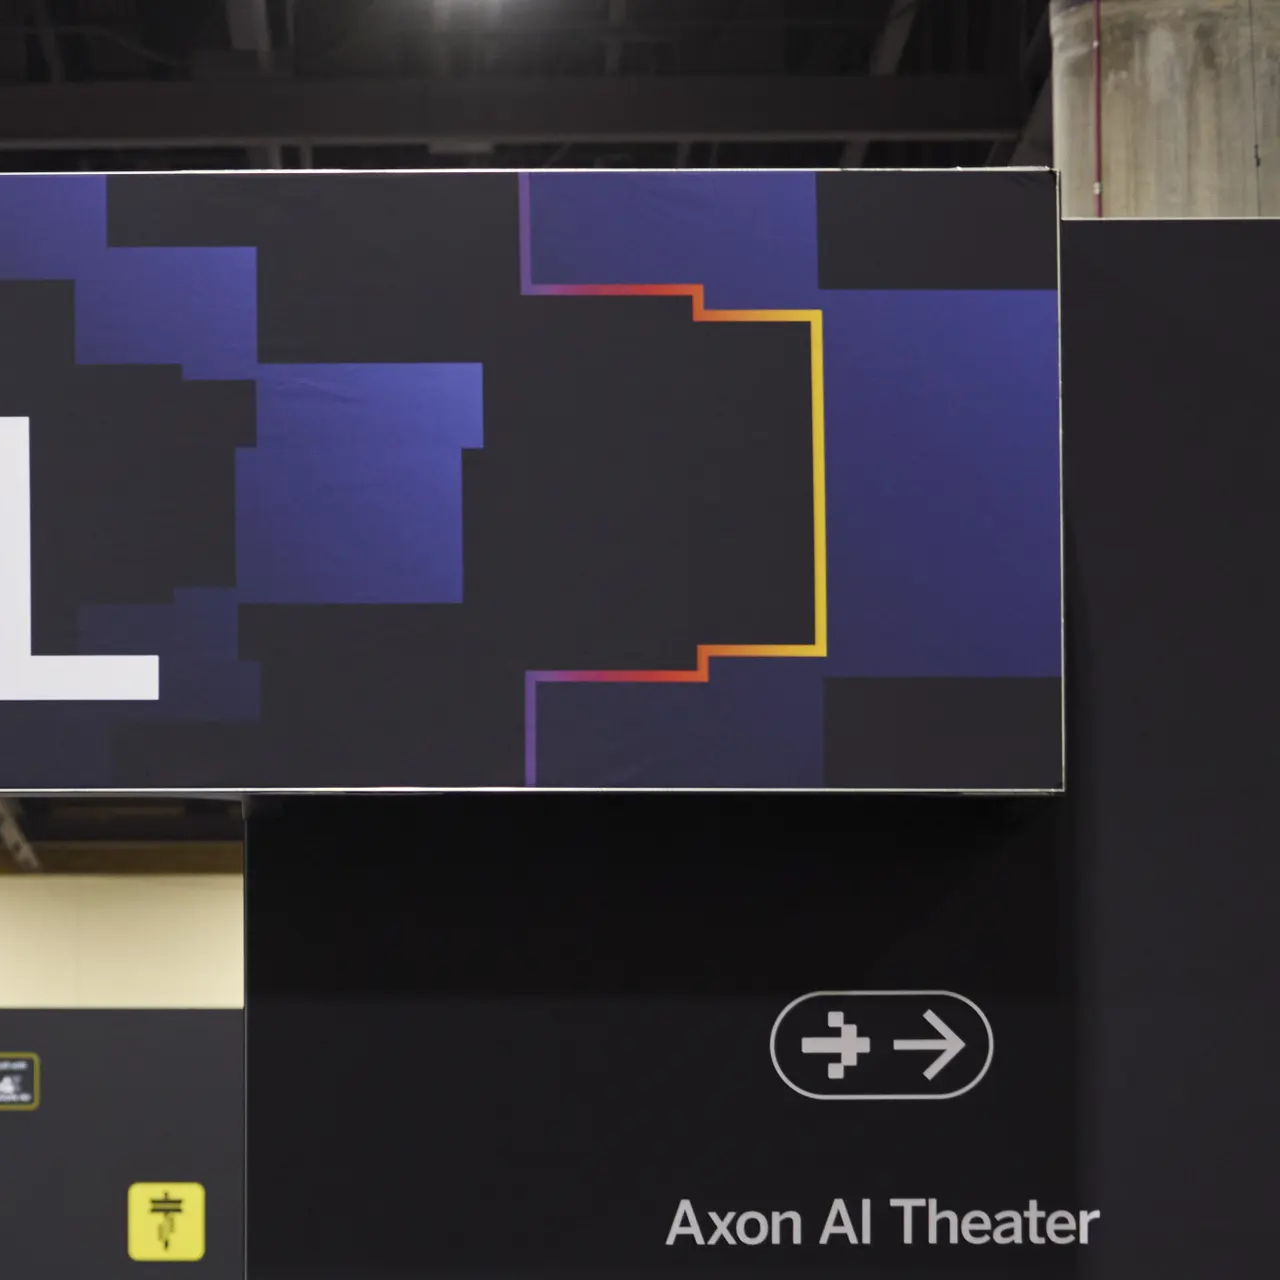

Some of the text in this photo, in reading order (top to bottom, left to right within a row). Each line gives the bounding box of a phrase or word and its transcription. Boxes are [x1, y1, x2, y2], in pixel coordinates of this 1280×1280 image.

[665, 1198, 1101, 1246] Axon AI Theater
